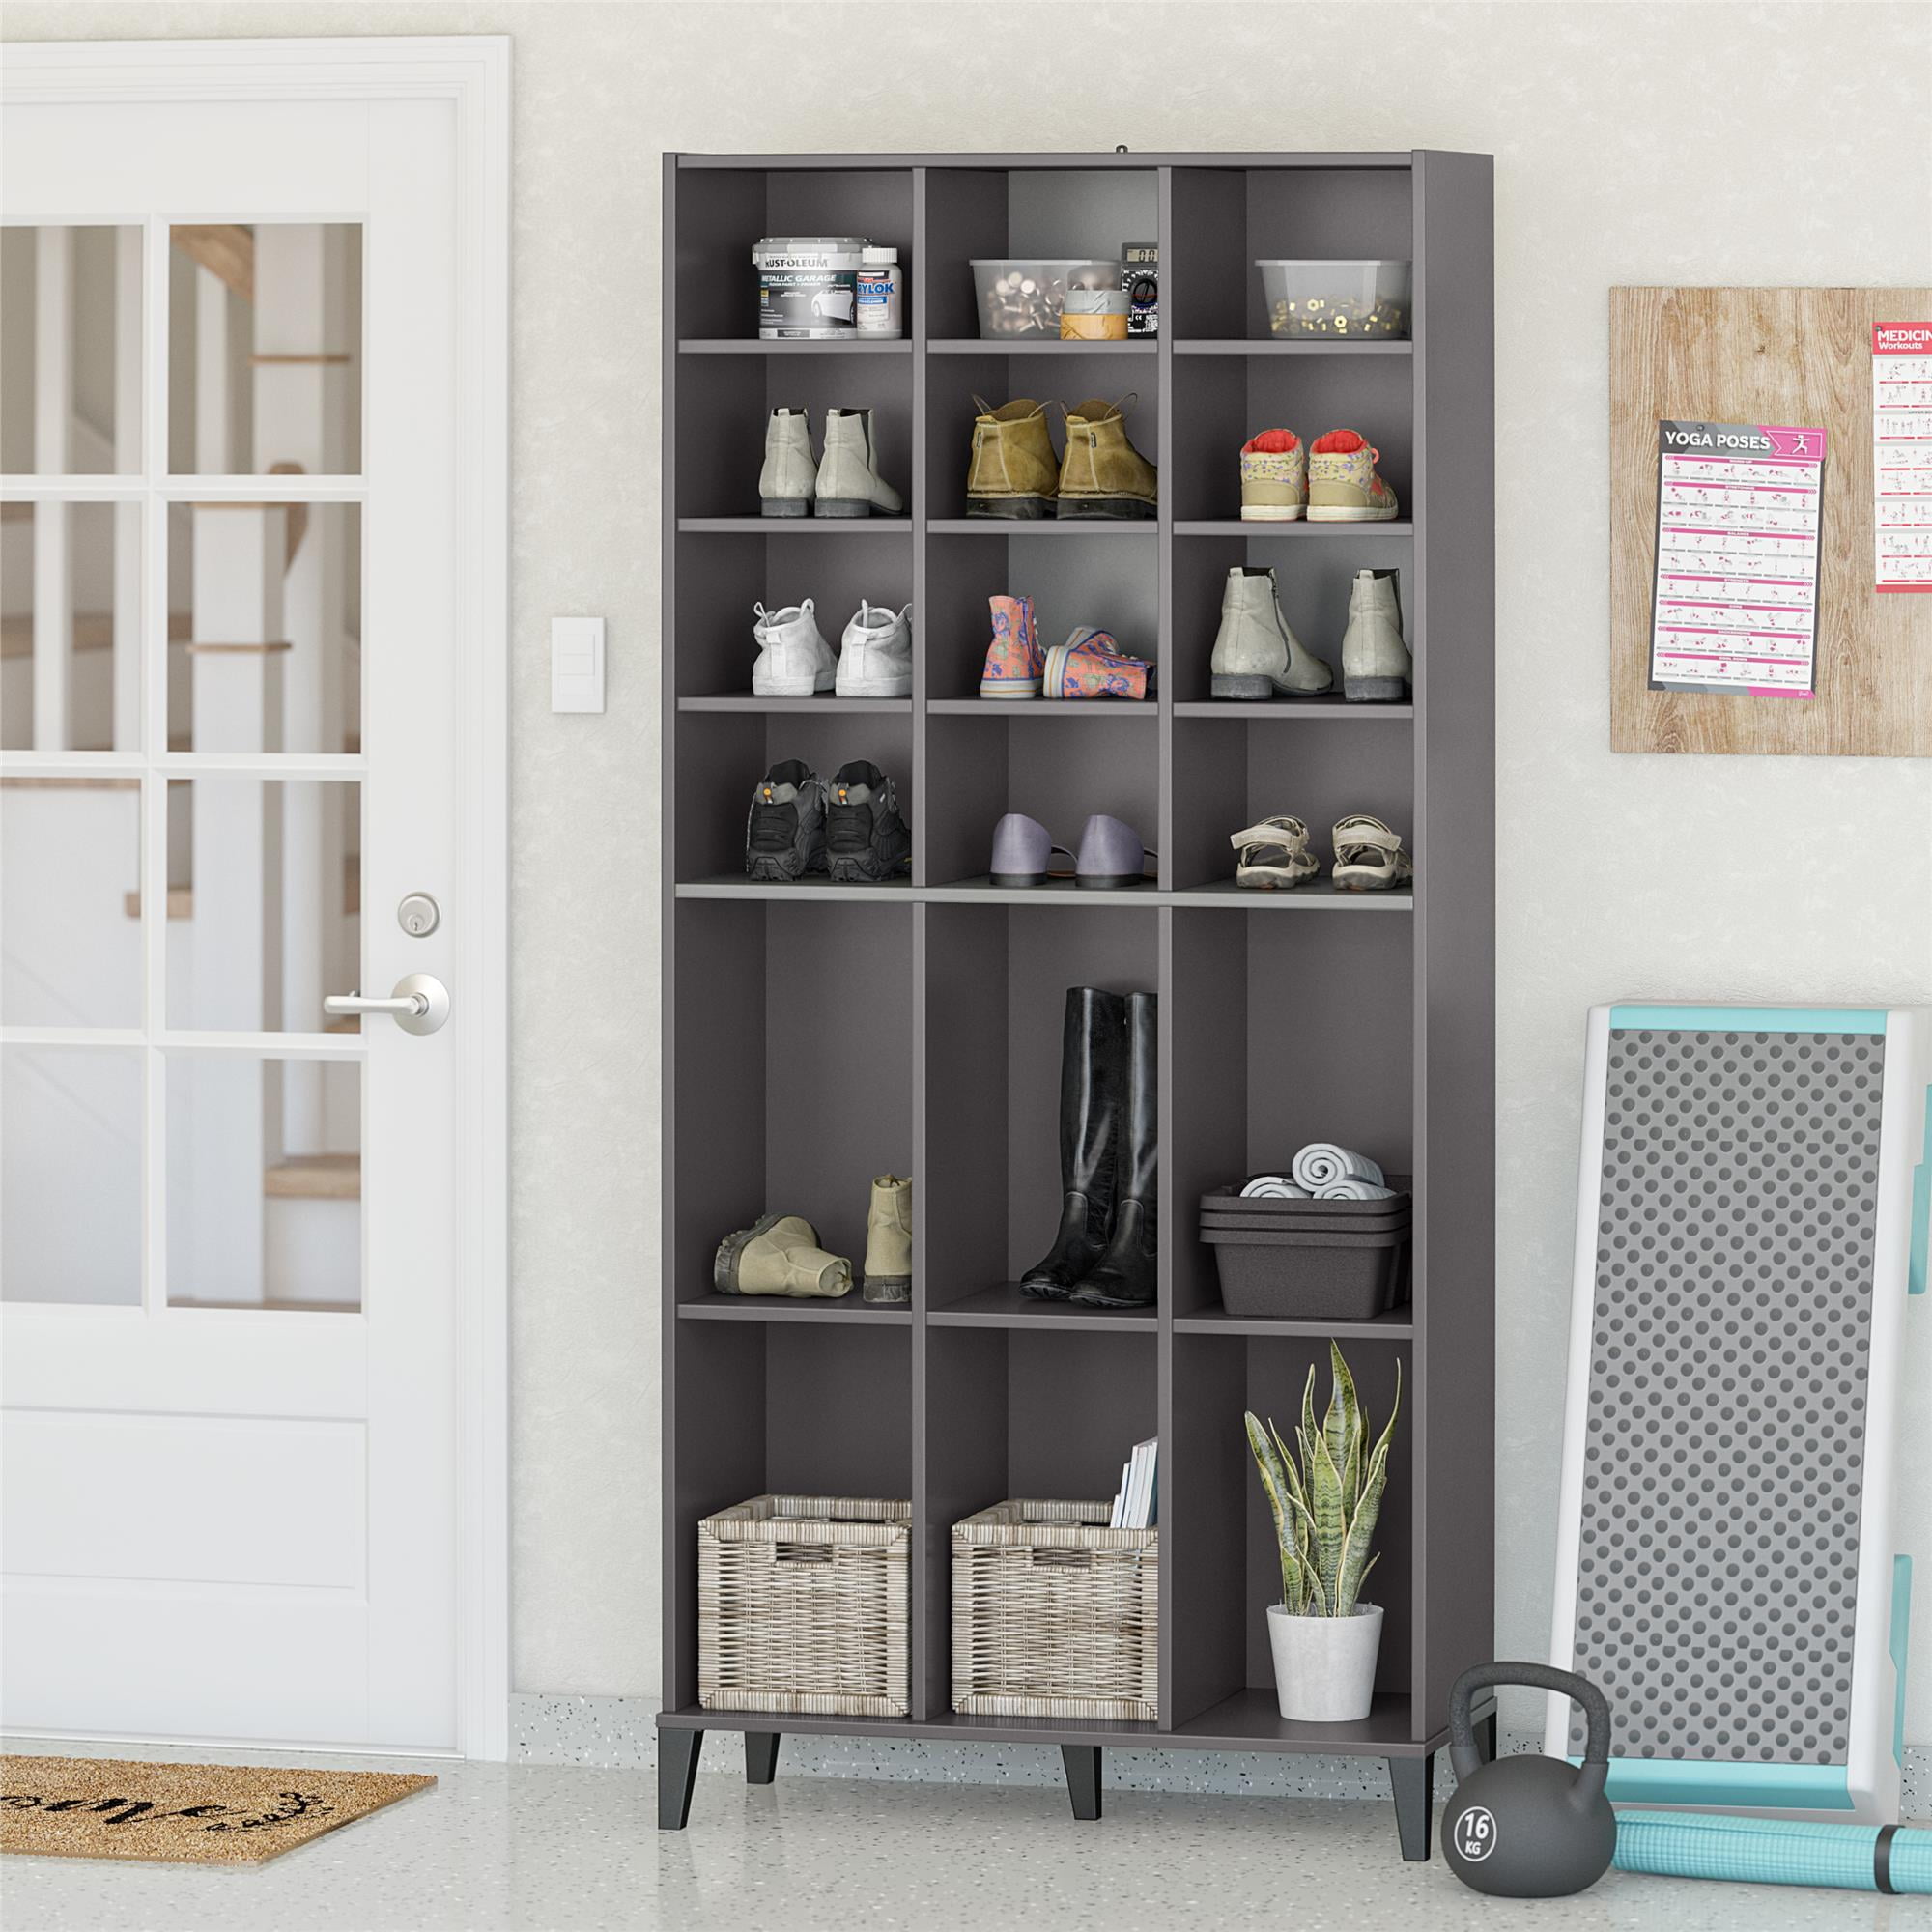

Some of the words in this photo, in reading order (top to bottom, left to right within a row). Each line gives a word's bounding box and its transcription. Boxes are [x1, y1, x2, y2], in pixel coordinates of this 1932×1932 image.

[795, 274, 837, 283] GARAGE
[1878, 341, 1923, 350] Workouts
[1665, 431, 1713, 447] YOGA
[1716, 434, 1771, 450] POSES
[1464, 1812, 1491, 1839] 16
[1464, 1840, 1481, 1855] KG
